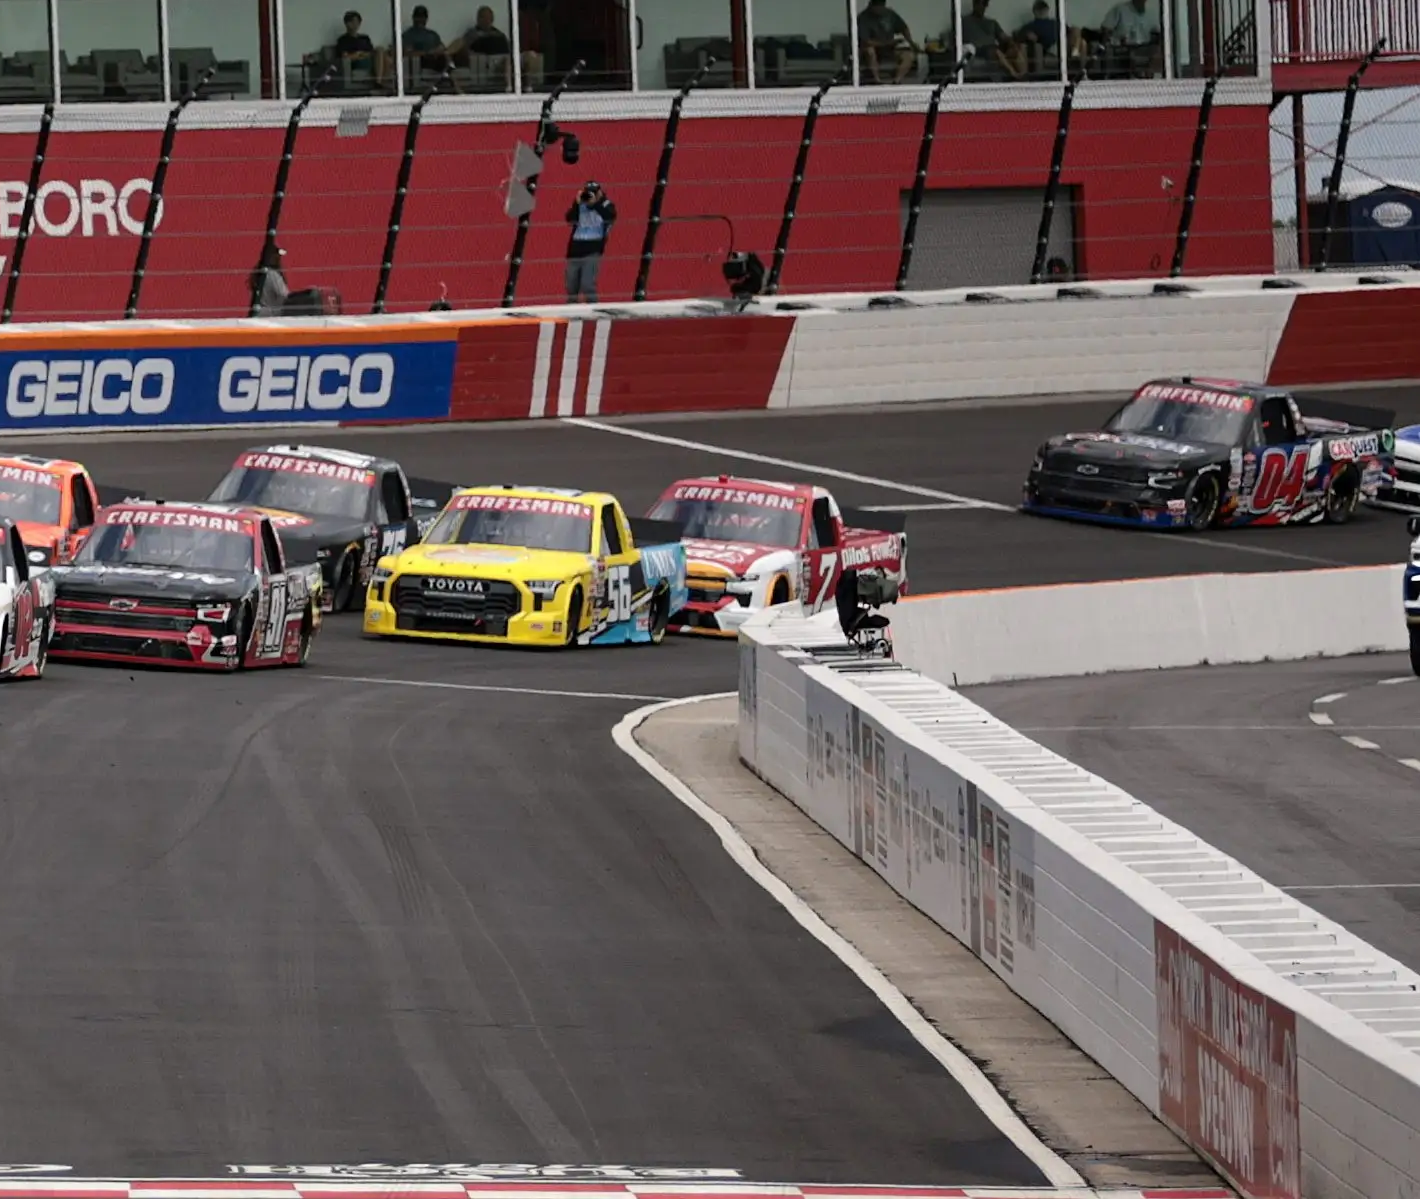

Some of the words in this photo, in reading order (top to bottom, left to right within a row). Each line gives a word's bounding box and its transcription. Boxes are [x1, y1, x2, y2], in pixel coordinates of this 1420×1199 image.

[6, 357, 176, 417] GEICO
[218, 352, 396, 412] GEICO
[1141, 385, 1243, 411] CRAFTSMAN
[244, 454, 366, 483] CRAFTSMAN
[1248, 444, 1310, 515] 04
[457, 496, 581, 517] CRAFTSMAN
[674, 487, 796, 511] CRAFTSMAN
[107, 511, 239, 533] CRAFTSMAN
[427, 577, 484, 593] TOYOTA
[608, 565, 631, 622] 56
[814, 551, 838, 615] 7
